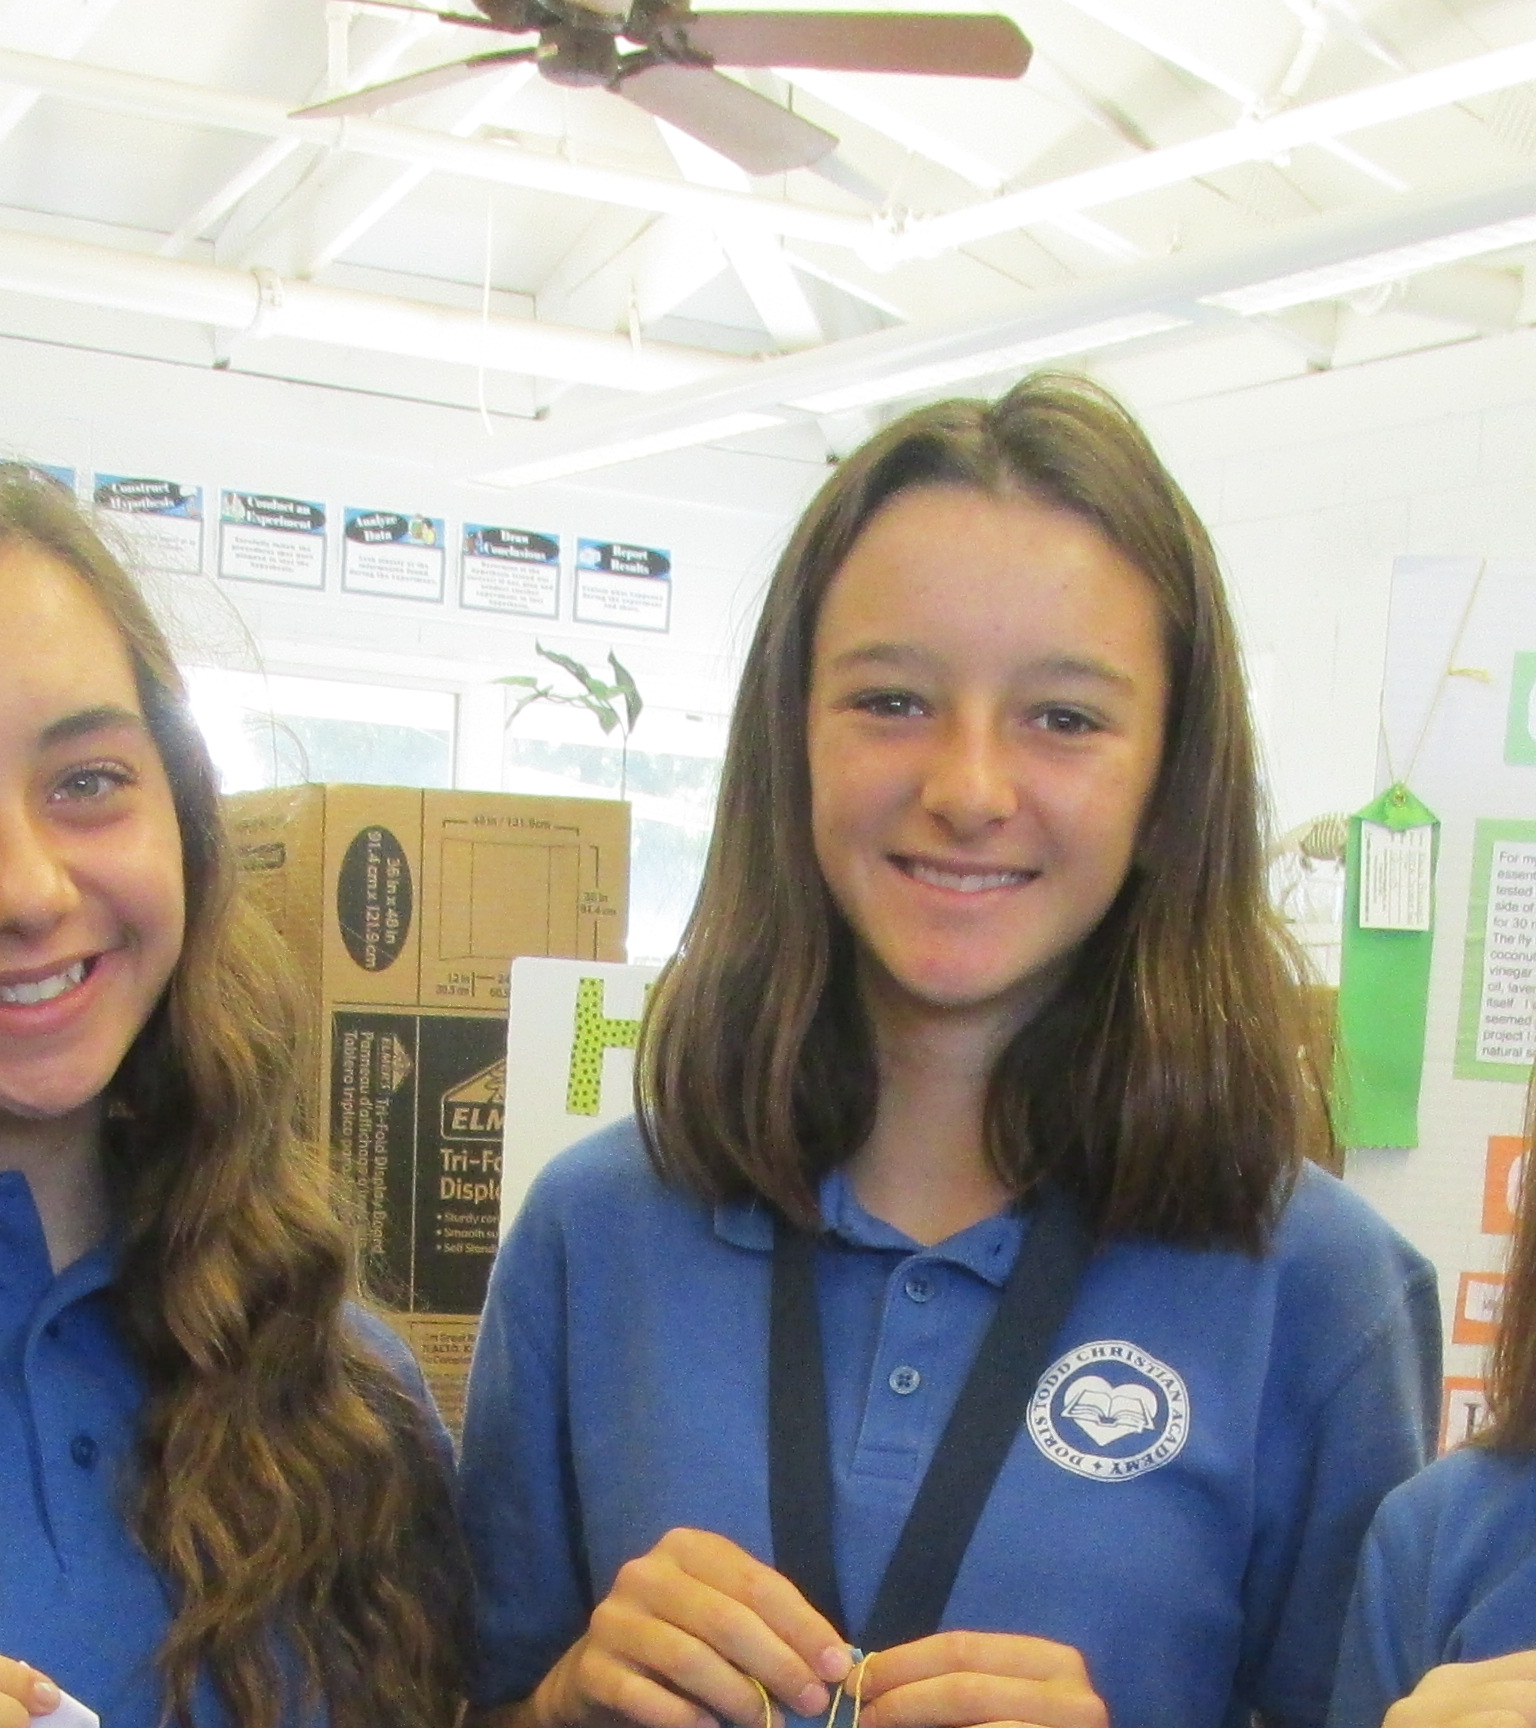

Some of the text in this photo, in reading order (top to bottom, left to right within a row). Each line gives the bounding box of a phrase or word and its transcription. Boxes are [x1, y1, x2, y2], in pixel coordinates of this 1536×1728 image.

[111, 482, 169, 494] Construct
[111, 497, 174, 512] Hypothesis
[247, 497, 311, 515] Conduct an
[246, 511, 312, 529] Experiment
[356, 514, 398, 529] Analyze
[364, 530, 392, 542] Data
[500, 530, 529, 544] Draw
[484, 543, 547, 560] Conclusions
[613, 545, 648, 561] Report
[611, 559, 650, 574] Results
[367, 831, 381, 863] 91.4
[1499, 851, 1518, 863] For
[385, 857, 400, 878] 36
[367, 865, 378, 889] cm
[385, 880, 398, 893] in
[1496, 886, 1533, 898] tested
[1495, 902, 1519, 912] side
[1523, 902, 1534, 913] of
[365, 905, 379, 942] 121.9
[385, 908, 399, 928] 48
[1493, 918, 1509, 928] for
[1512, 918, 1528, 929] 30
[384, 930, 398, 944] in
[1493, 933, 1515, 944] The
[1518, 934, 1532, 946] fly
[365, 945, 376, 968] cm
[1490, 949, 1536, 962] coconut
[1489, 966, 1532, 980] vinegar
[1485, 1014, 1532, 1026] seemed
[1482, 1031, 1523, 1047] project
[342, 1031, 357, 1085] Tablero
[1482, 1046, 1523, 1058] natural
[358, 1031, 373, 1094] Panneau
[375, 1098, 389, 1153] Tri-Fold
[451, 1106, 504, 1130] ELM
[372, 1155, 387, 1208] Display
[444, 1228, 484, 1239] Smooth
[1034, 1346, 1183, 1475] DORIS TODD CHRISTIAN ACADEMY
